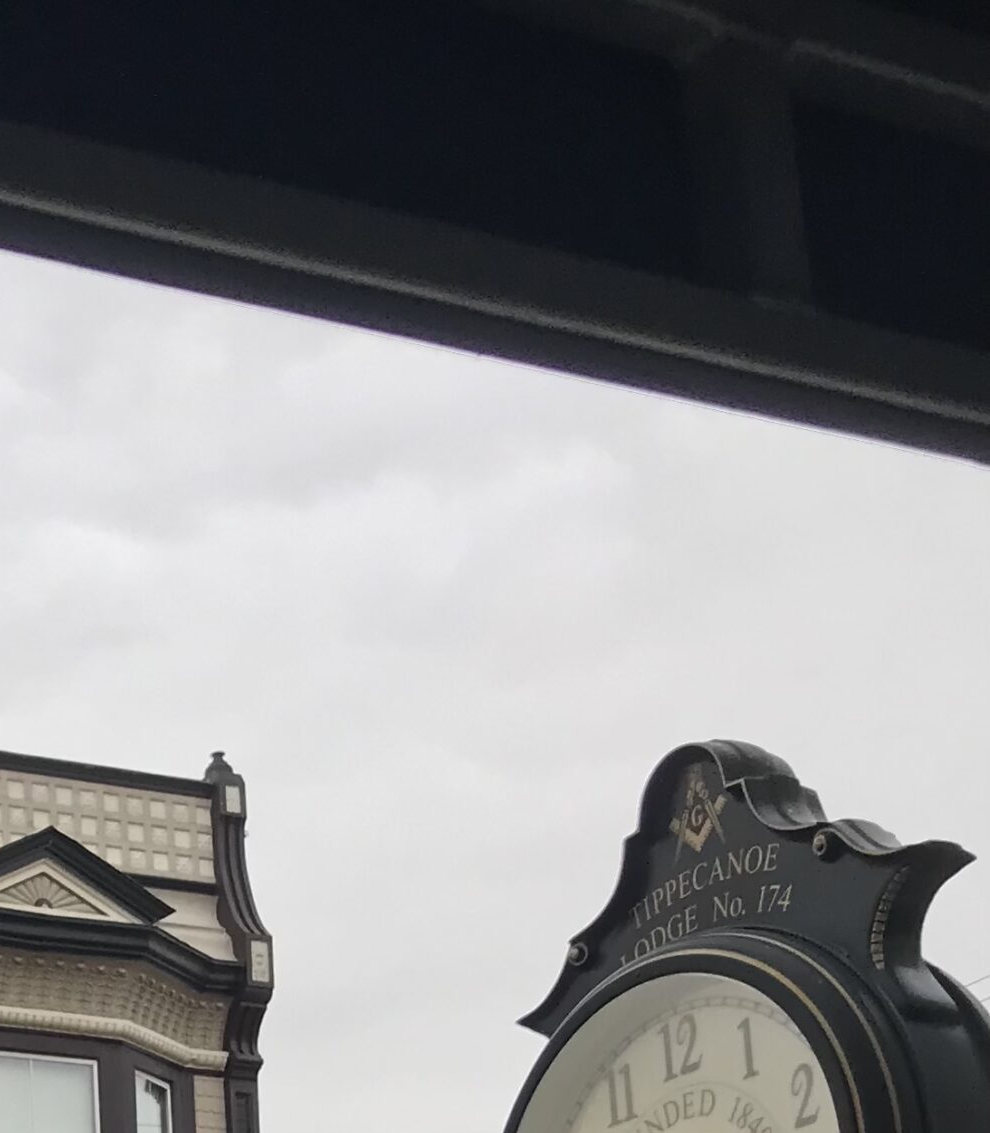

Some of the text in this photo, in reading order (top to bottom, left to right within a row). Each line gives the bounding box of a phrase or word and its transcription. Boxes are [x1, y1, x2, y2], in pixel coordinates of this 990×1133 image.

[629, 843, 780, 929] TIPPECANOE
[713, 892, 746, 922] No.
[757, 884, 793, 913] 174
[658, 1013, 703, 1083] 12
[737, 1017, 759, 1080] 1
[607, 1063, 638, 1128] 11
[790, 1062, 820, 1129] 2
